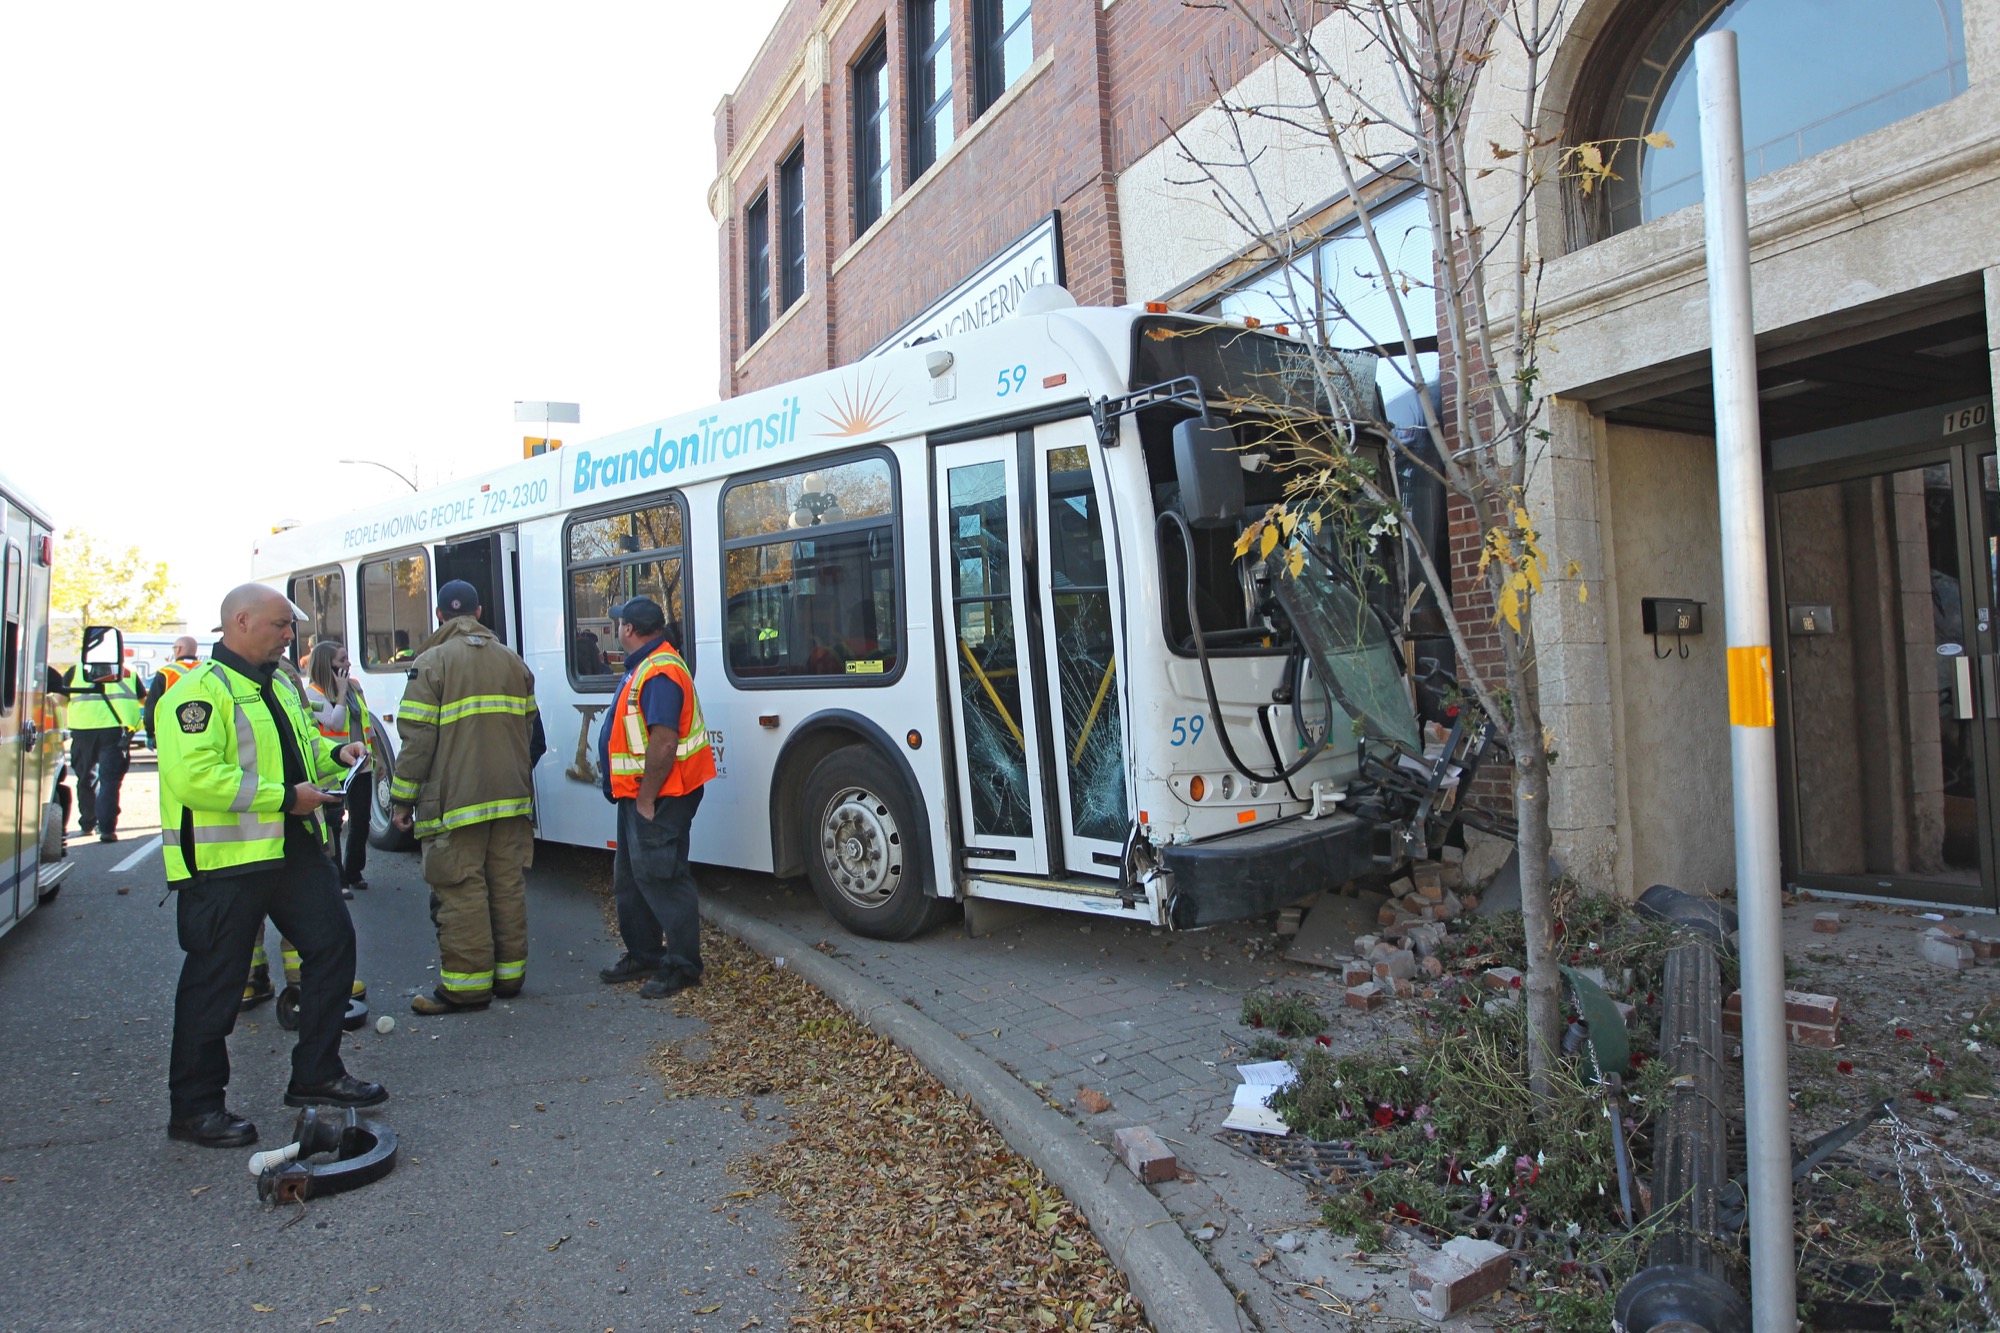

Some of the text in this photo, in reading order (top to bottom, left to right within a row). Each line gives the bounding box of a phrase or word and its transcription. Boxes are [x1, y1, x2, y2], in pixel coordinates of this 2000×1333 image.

[932, 256, 1045, 339] NGINEERING
[996, 364, 1027, 397] 59
[1947, 405, 1986, 433] 160
[344, 478, 548, 548] PEOPLE MOVING PEOPLE 729-2300
[1169, 714, 1205, 747] 59
